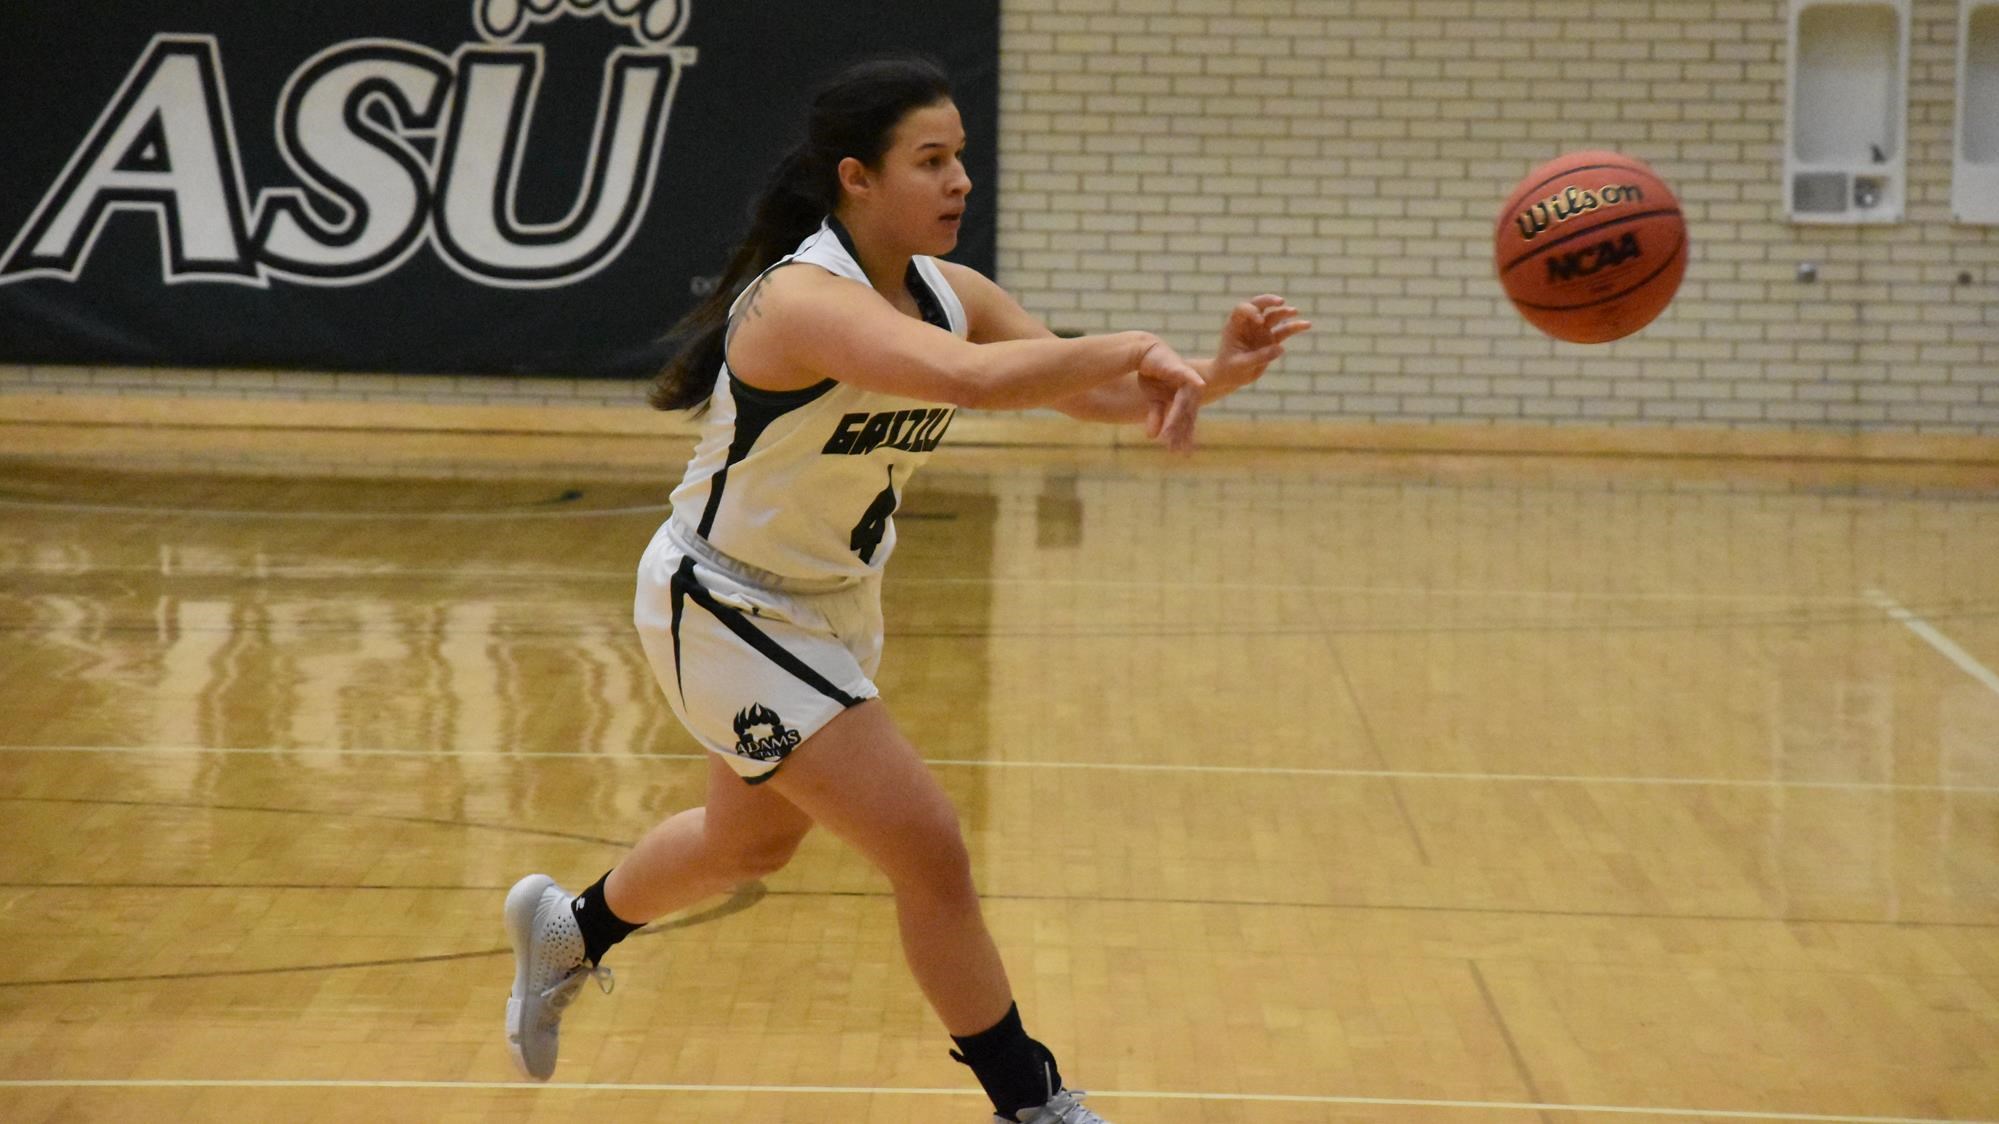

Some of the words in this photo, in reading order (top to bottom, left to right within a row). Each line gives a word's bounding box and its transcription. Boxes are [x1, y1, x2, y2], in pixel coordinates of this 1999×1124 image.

[0, 33, 682, 290] ASU
[1515, 184, 1644, 240] Wilson
[1547, 232, 1640, 281] NCAA
[850, 464, 897, 565] 4
[736, 730, 800, 754] ADAMS
